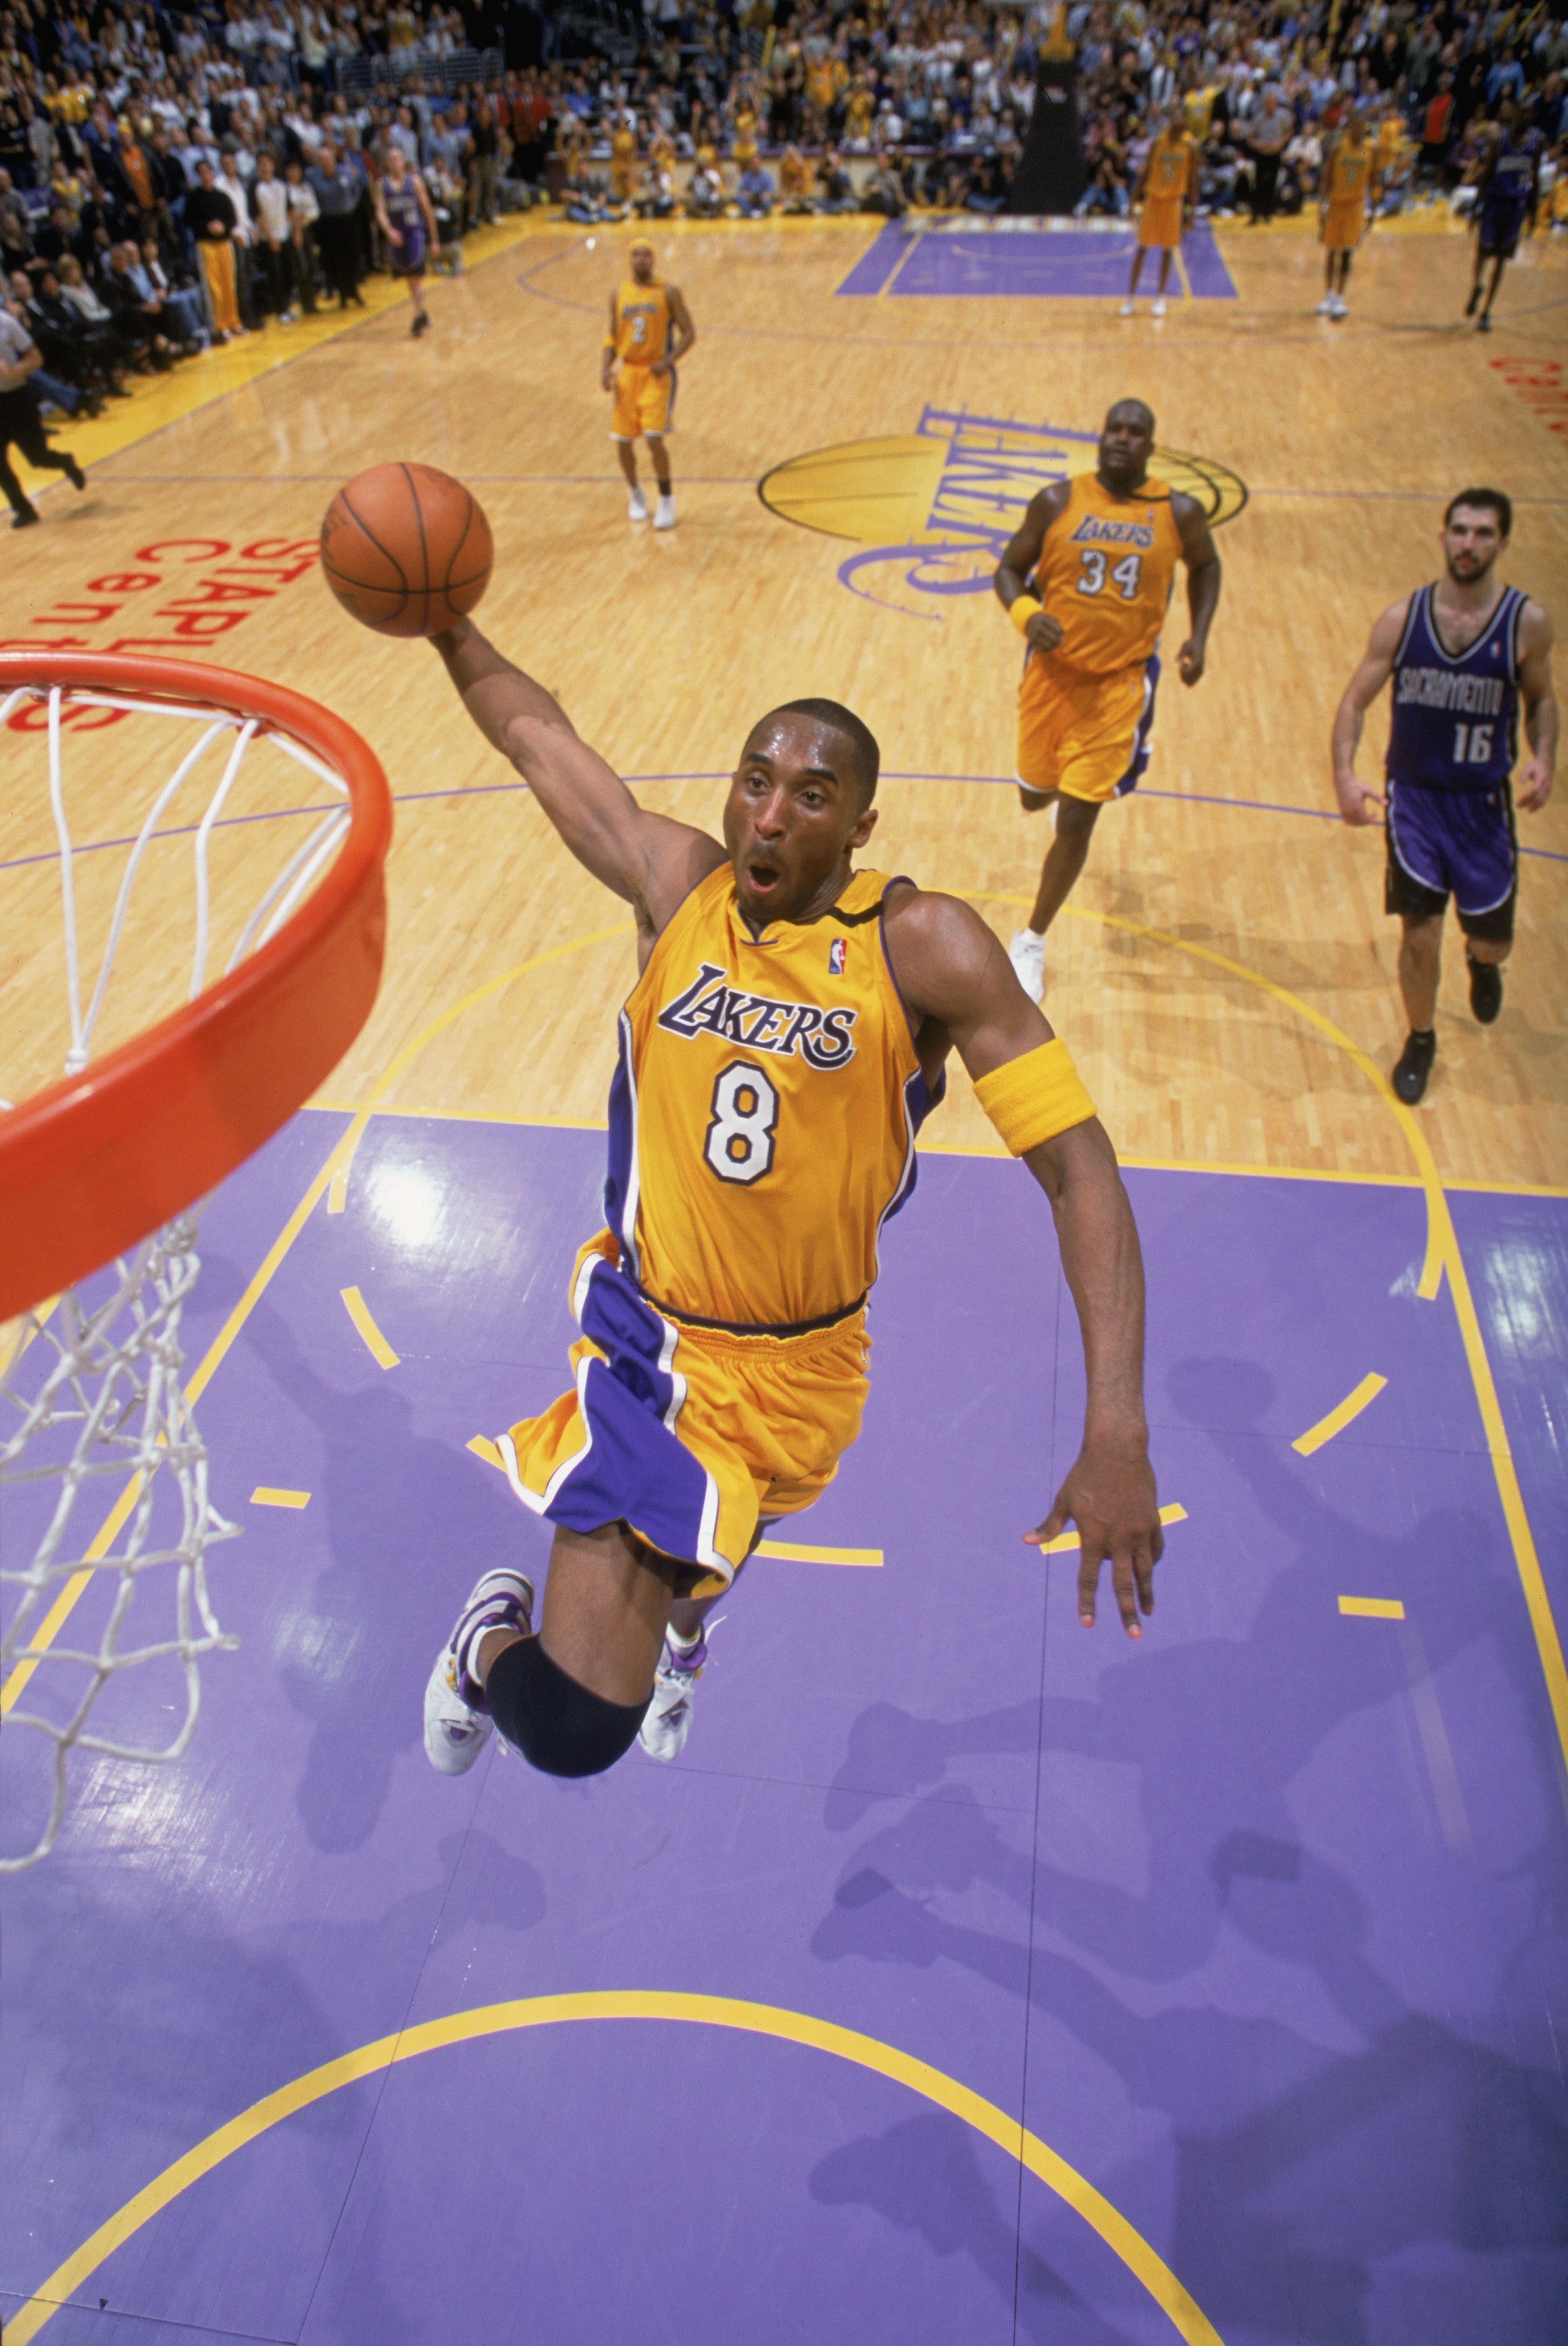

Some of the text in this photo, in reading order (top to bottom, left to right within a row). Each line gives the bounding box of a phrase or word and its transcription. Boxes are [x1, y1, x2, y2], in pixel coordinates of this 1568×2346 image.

[1068, 513, 1155, 548] LAKERS
[1077, 548, 1141, 600] 34
[7, 539, 321, 732] STAPLS
[1452, 723, 1494, 764] 16
[658, 962, 858, 1071] LAKERS
[703, 1059, 780, 1186] 8
